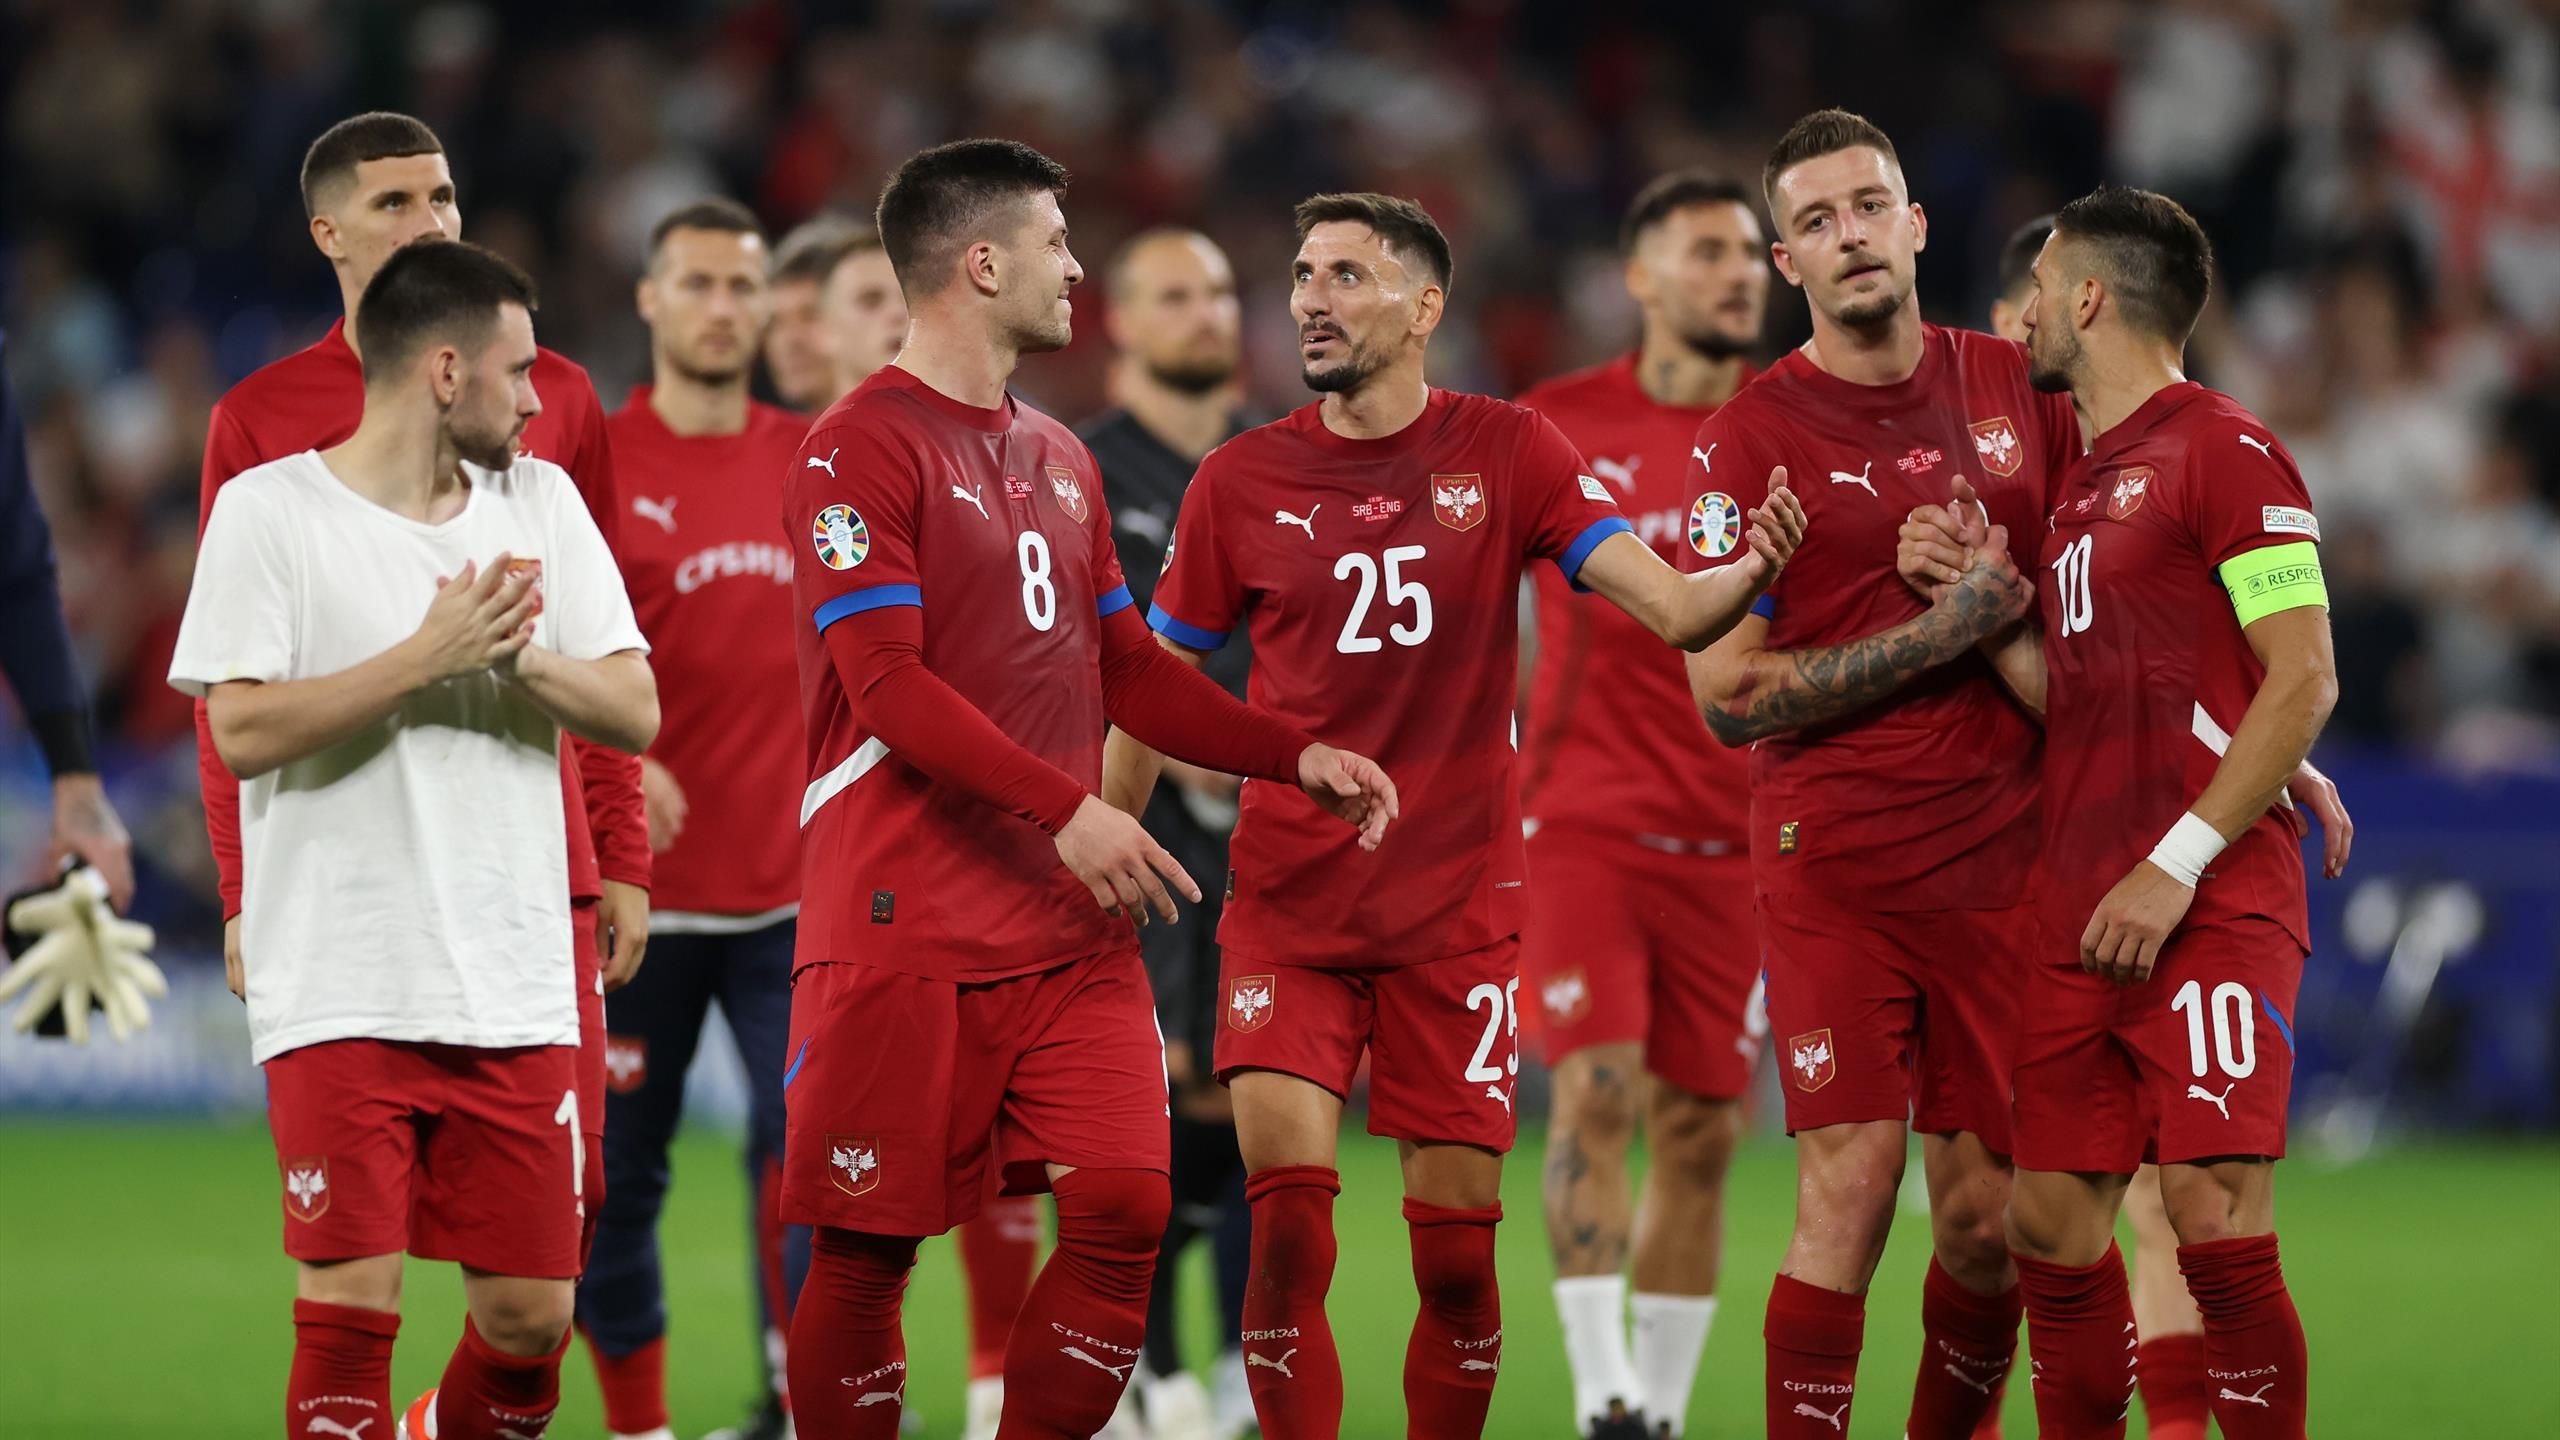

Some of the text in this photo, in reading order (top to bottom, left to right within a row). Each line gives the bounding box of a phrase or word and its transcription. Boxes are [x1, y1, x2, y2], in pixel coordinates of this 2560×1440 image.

[1896, 450, 1942, 471] SRB-ENG
[1352, 501, 1401, 516] SRB-ENG
[1018, 530, 1056, 632] 8
[1333, 544, 1433, 654] 25
[2051, 533, 2094, 638] 10
[2171, 979, 2257, 1079] 10
[1241, 1327, 1299, 1341] СРБИЈА
[1783, 1380, 1853, 1394] СРБИЈА
